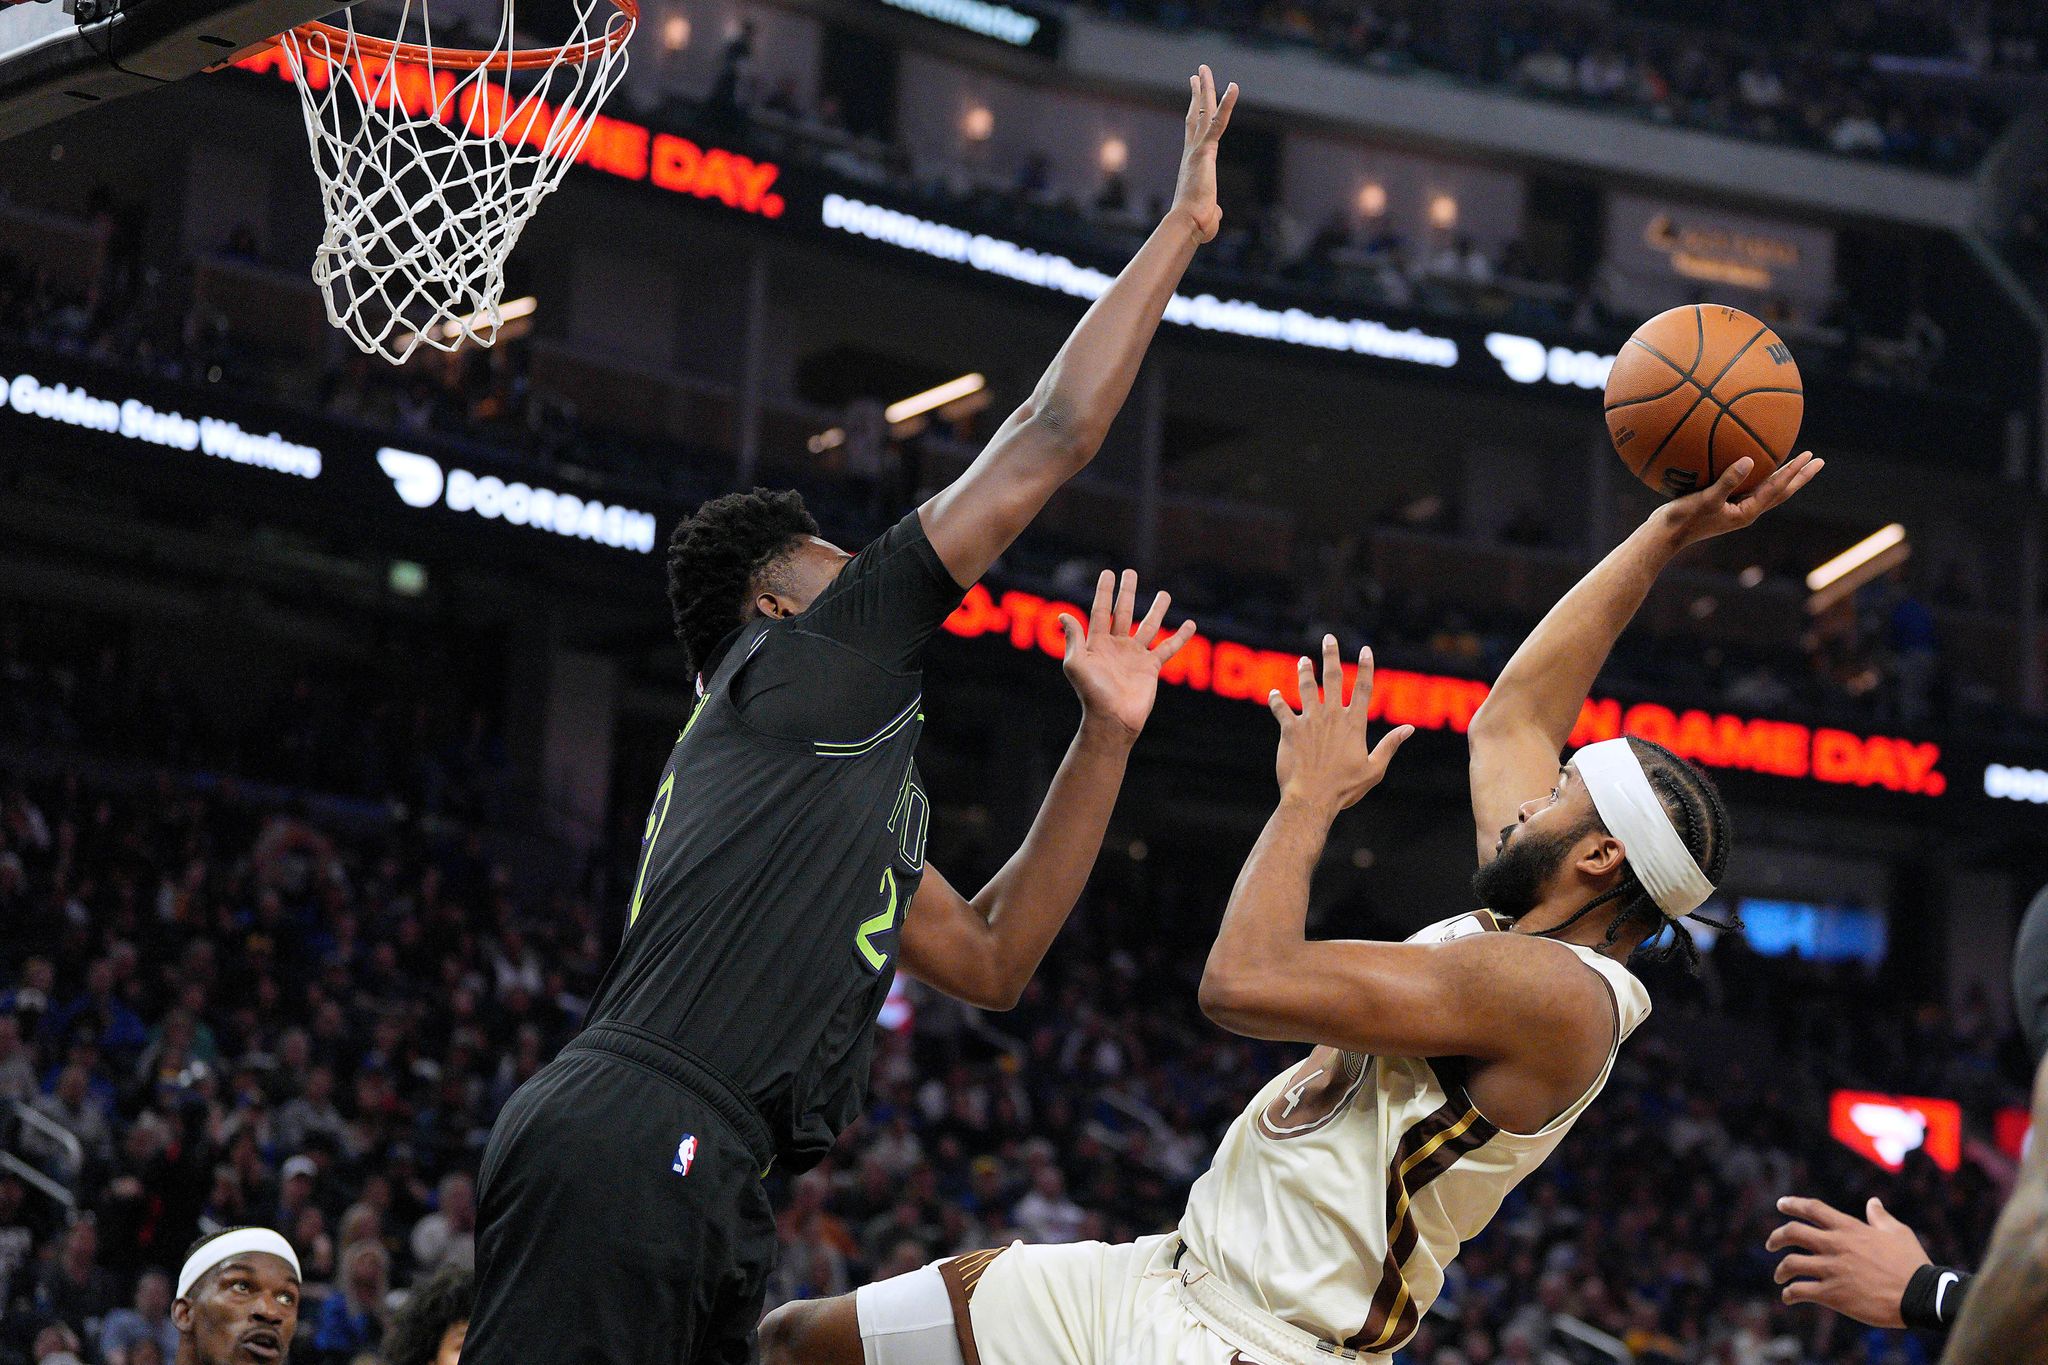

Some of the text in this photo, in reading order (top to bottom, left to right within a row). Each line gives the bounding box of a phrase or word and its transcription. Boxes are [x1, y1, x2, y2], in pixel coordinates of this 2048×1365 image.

[651, 132, 786, 220] DAY.
[446, 468, 657, 554] DOORDASH
[1812, 727, 1947, 797] DAY.
